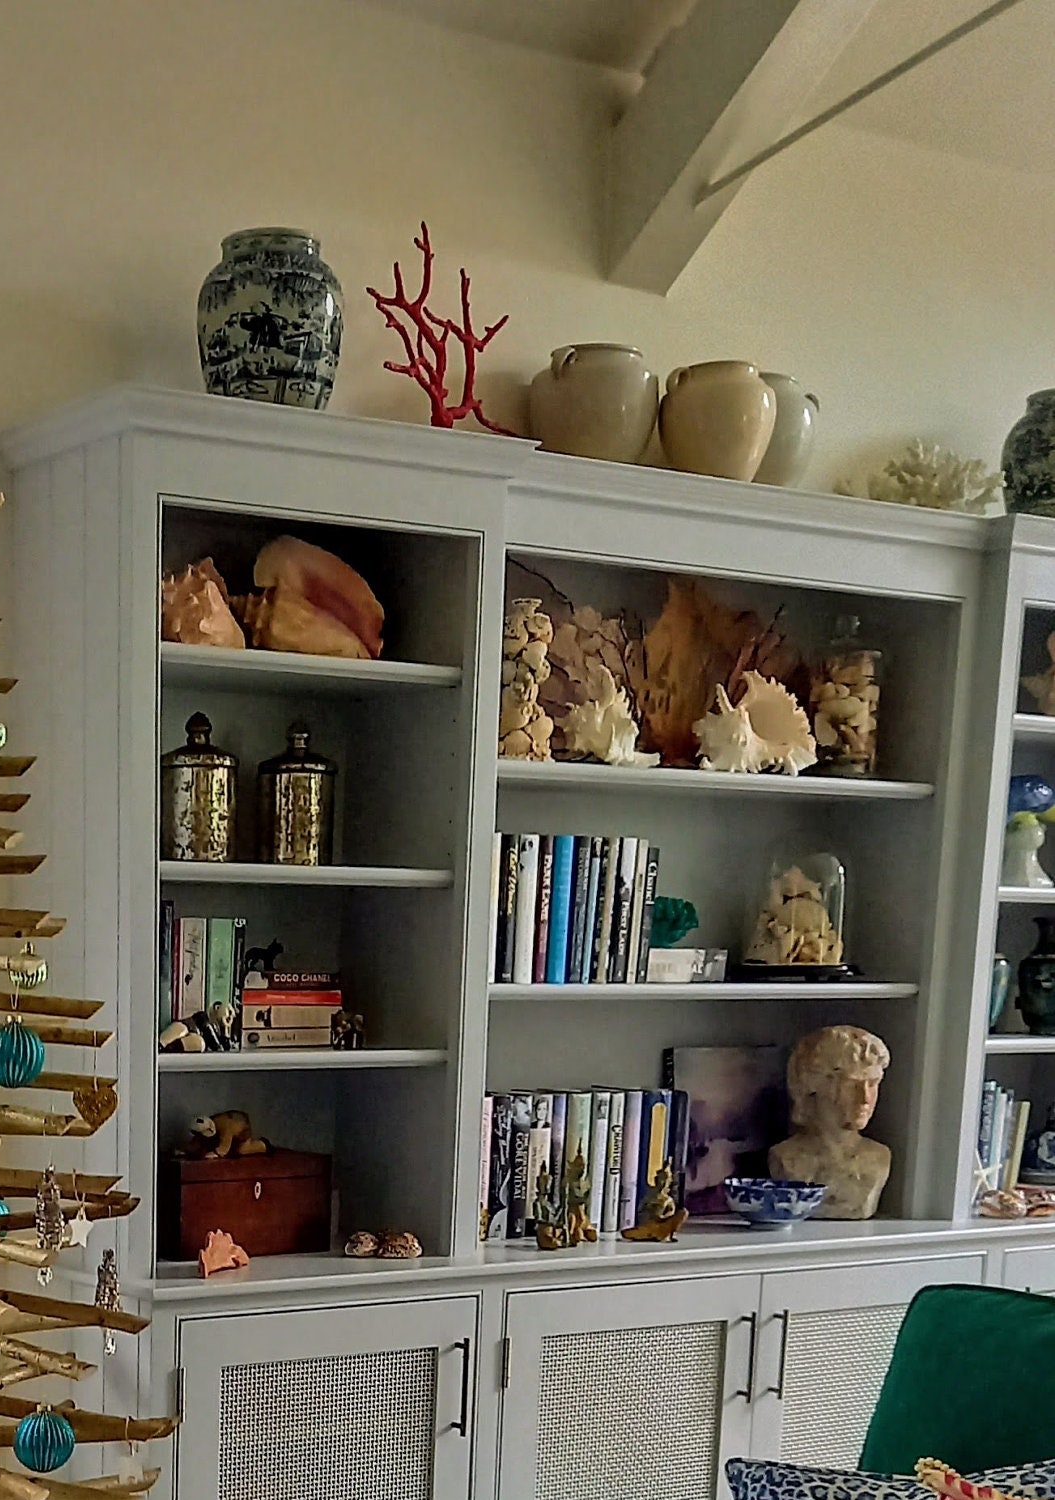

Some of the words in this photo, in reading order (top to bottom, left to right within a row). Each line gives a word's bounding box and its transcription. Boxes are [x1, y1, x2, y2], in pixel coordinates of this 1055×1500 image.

[645, 862, 658, 905] Chanel
[274, 973, 299, 983] COCO
[301, 973, 332, 983] CHANEL
[514, 1132, 524, 1166] GORE
[513, 1166, 523, 1200] VIDAL
